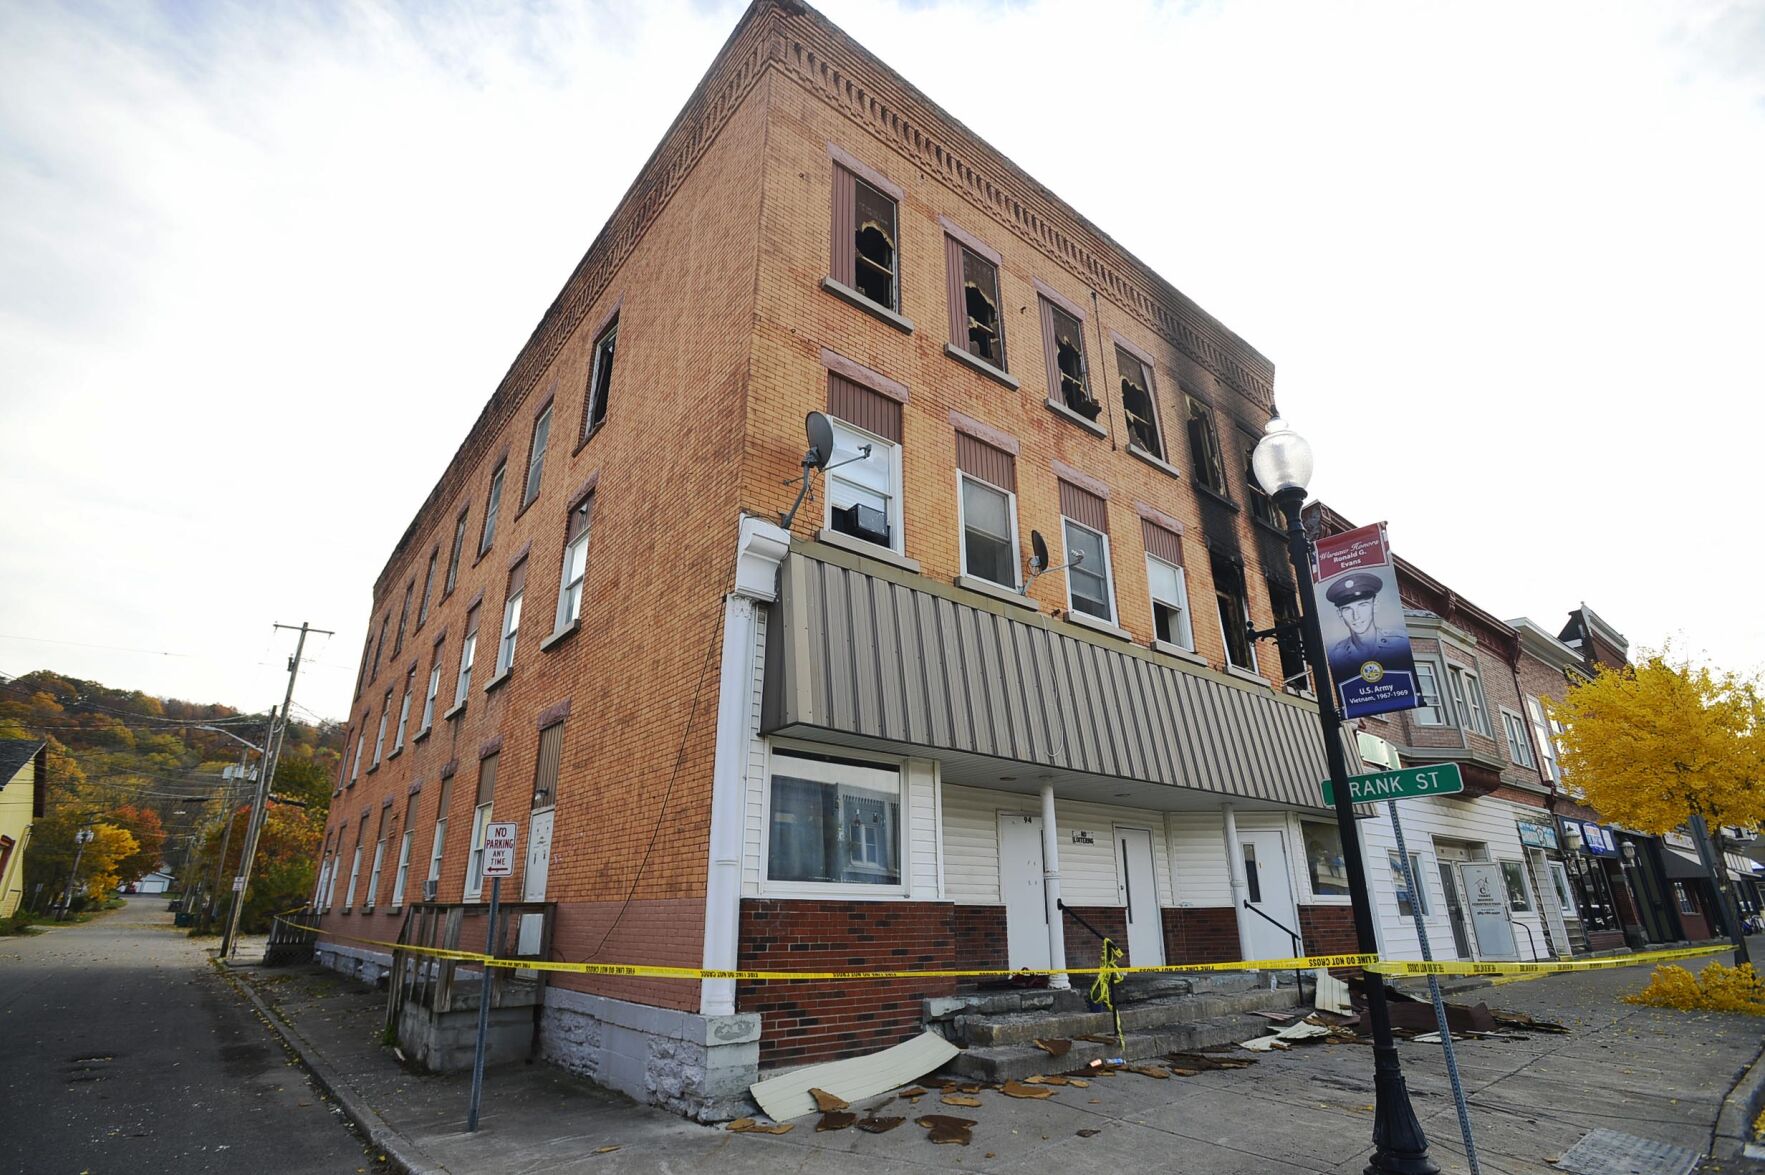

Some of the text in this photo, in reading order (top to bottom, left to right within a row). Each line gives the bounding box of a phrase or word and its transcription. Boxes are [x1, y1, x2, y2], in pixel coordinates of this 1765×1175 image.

[1350, 540, 1379, 552] Honors
[1334, 551, 1358, 563] Ronald
[1340, 559, 1361, 568] Evans
[1374, 684, 1393, 692] Army
[1350, 690, 1408, 704] Vietnam, 1967-1969
[1348, 772, 1439, 798] RANK ST
[494, 828, 507, 837] NO
[486, 839, 514, 849] PARKING
[1309, 958, 1330, 966] CROSS
[1332, 957, 1344, 965] NOT
[1357, 956, 1371, 964] LINE
